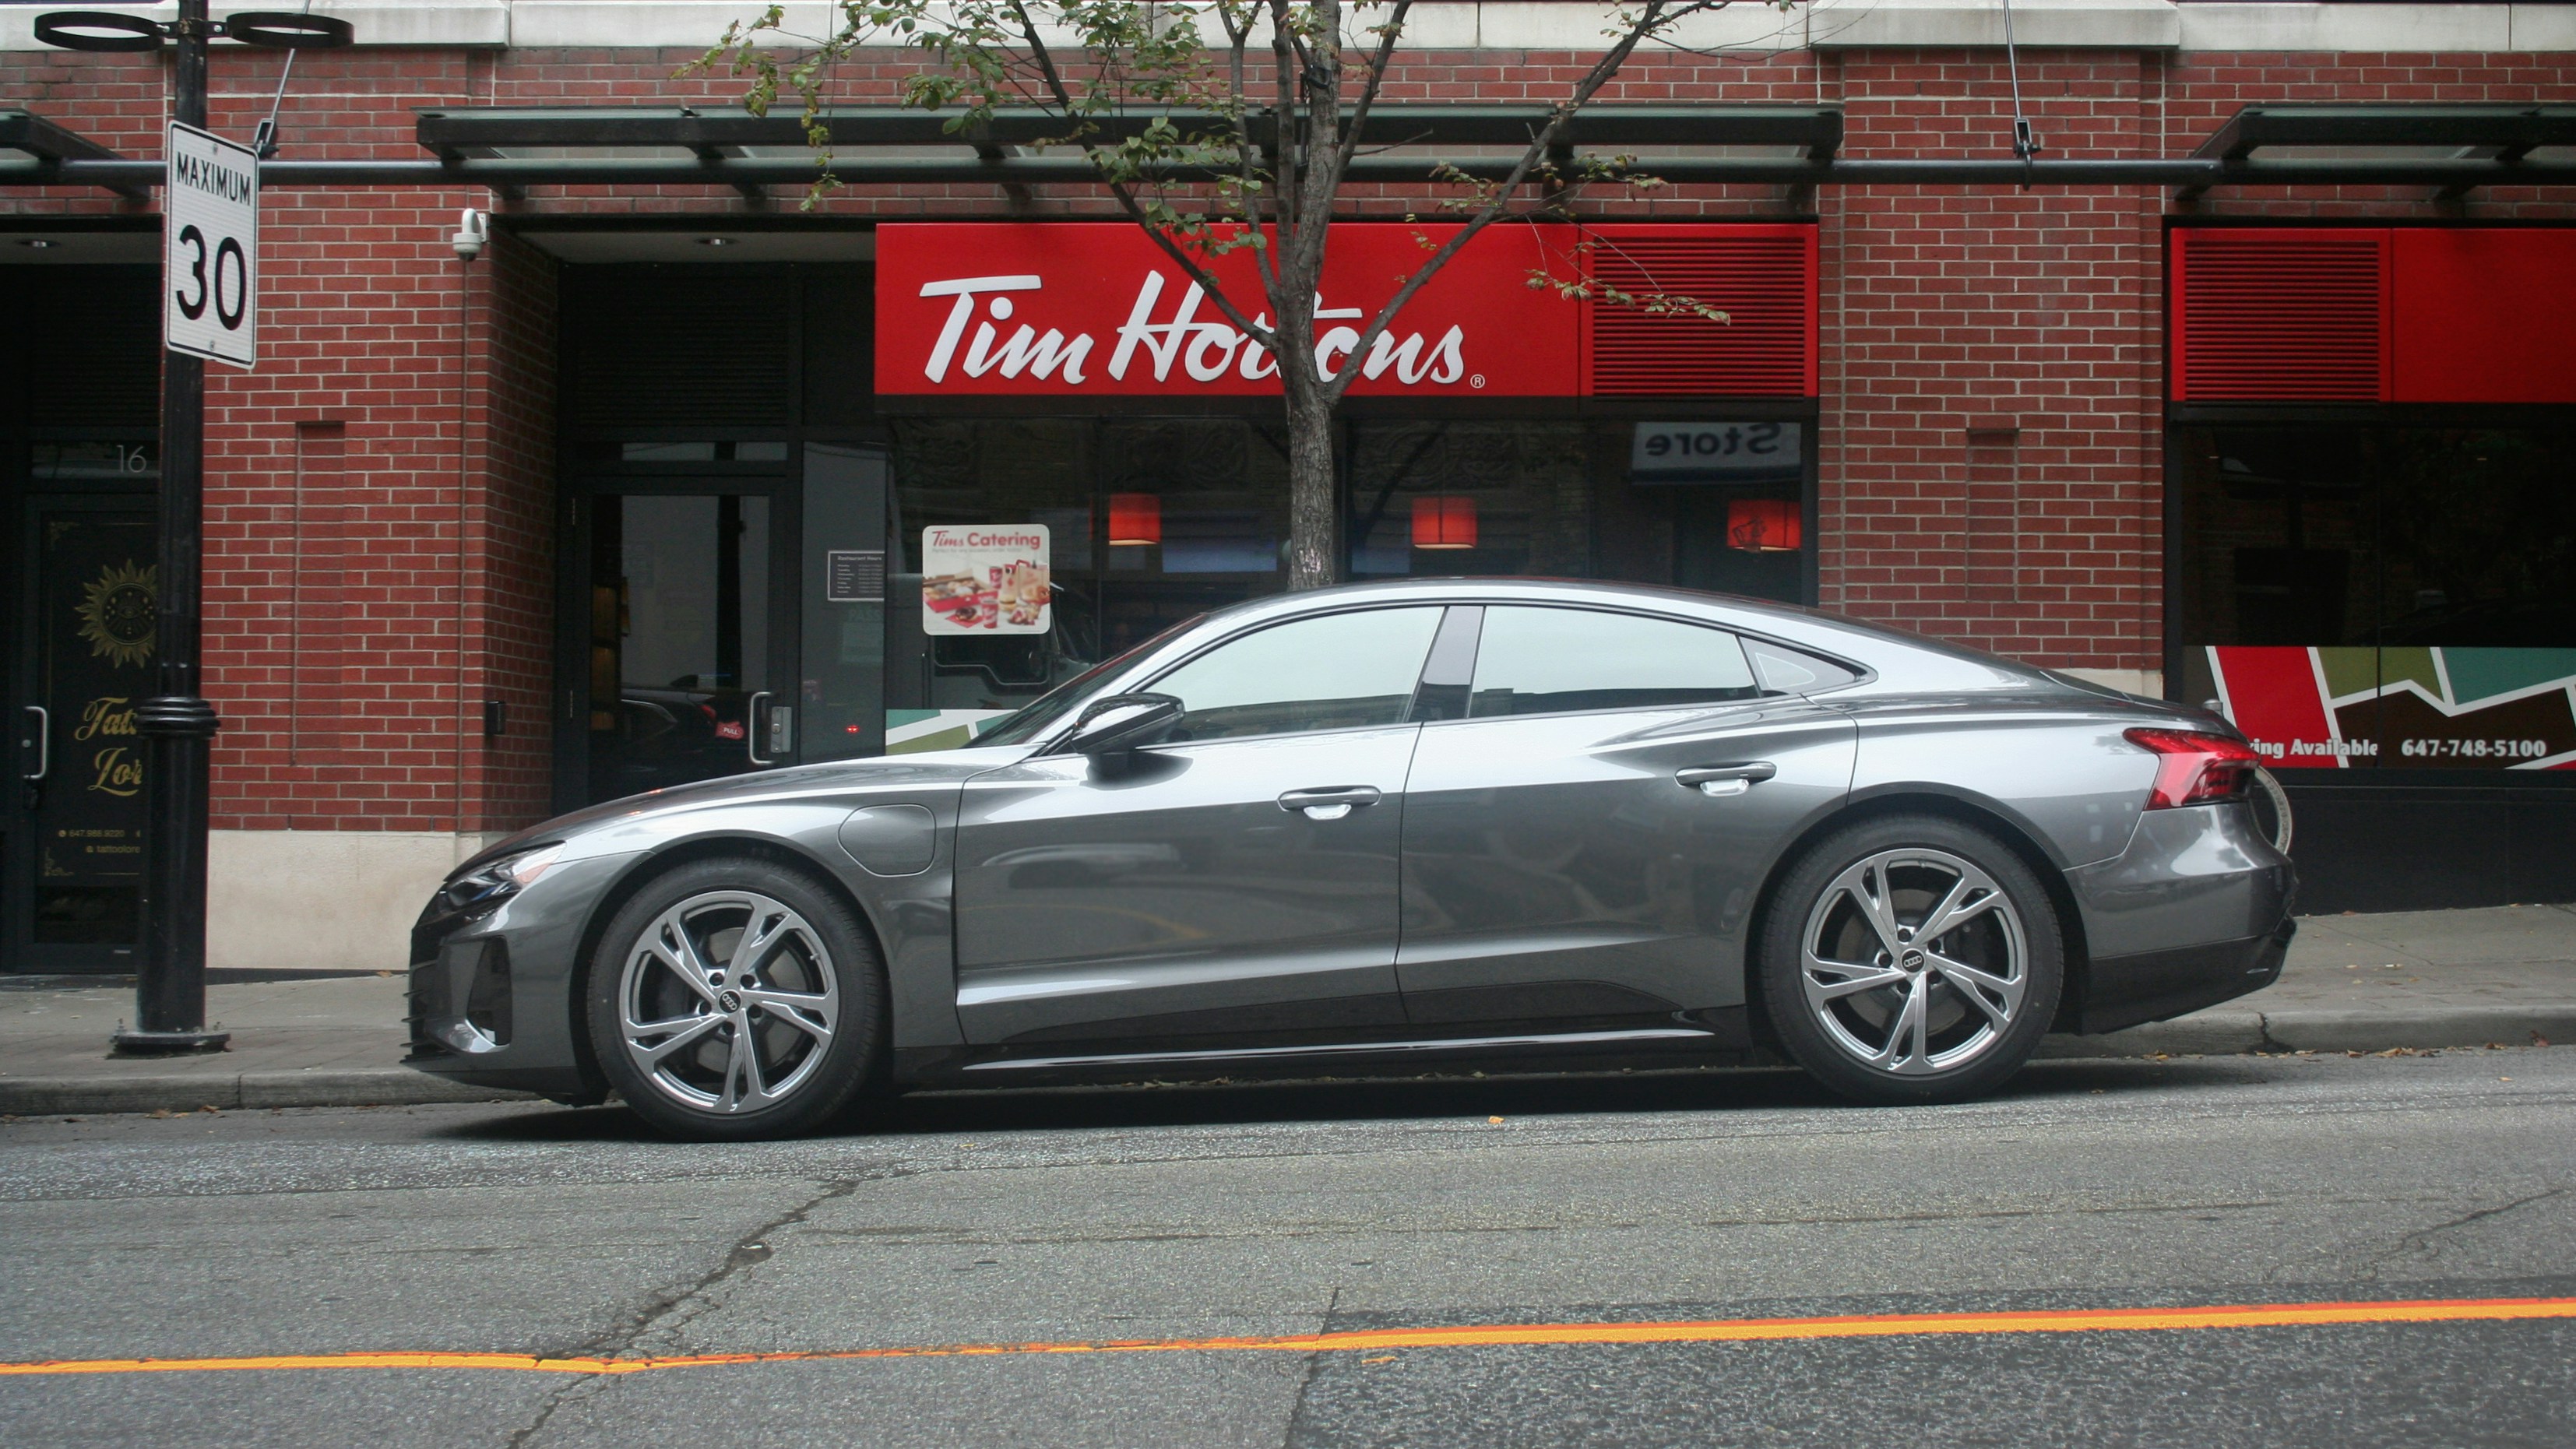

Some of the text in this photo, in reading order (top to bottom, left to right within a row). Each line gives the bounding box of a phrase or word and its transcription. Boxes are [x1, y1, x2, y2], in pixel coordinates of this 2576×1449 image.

[177, 151, 250, 206] MAXIMUM
[176, 224, 247, 331] 30
[920, 274, 1094, 384] Tim
[116, 445, 146, 473] 16
[931, 530, 1040, 550] Tims Catering
[2289, 738, 2378, 756] Available
[2401, 739, 2546, 757] 647-748-5100
